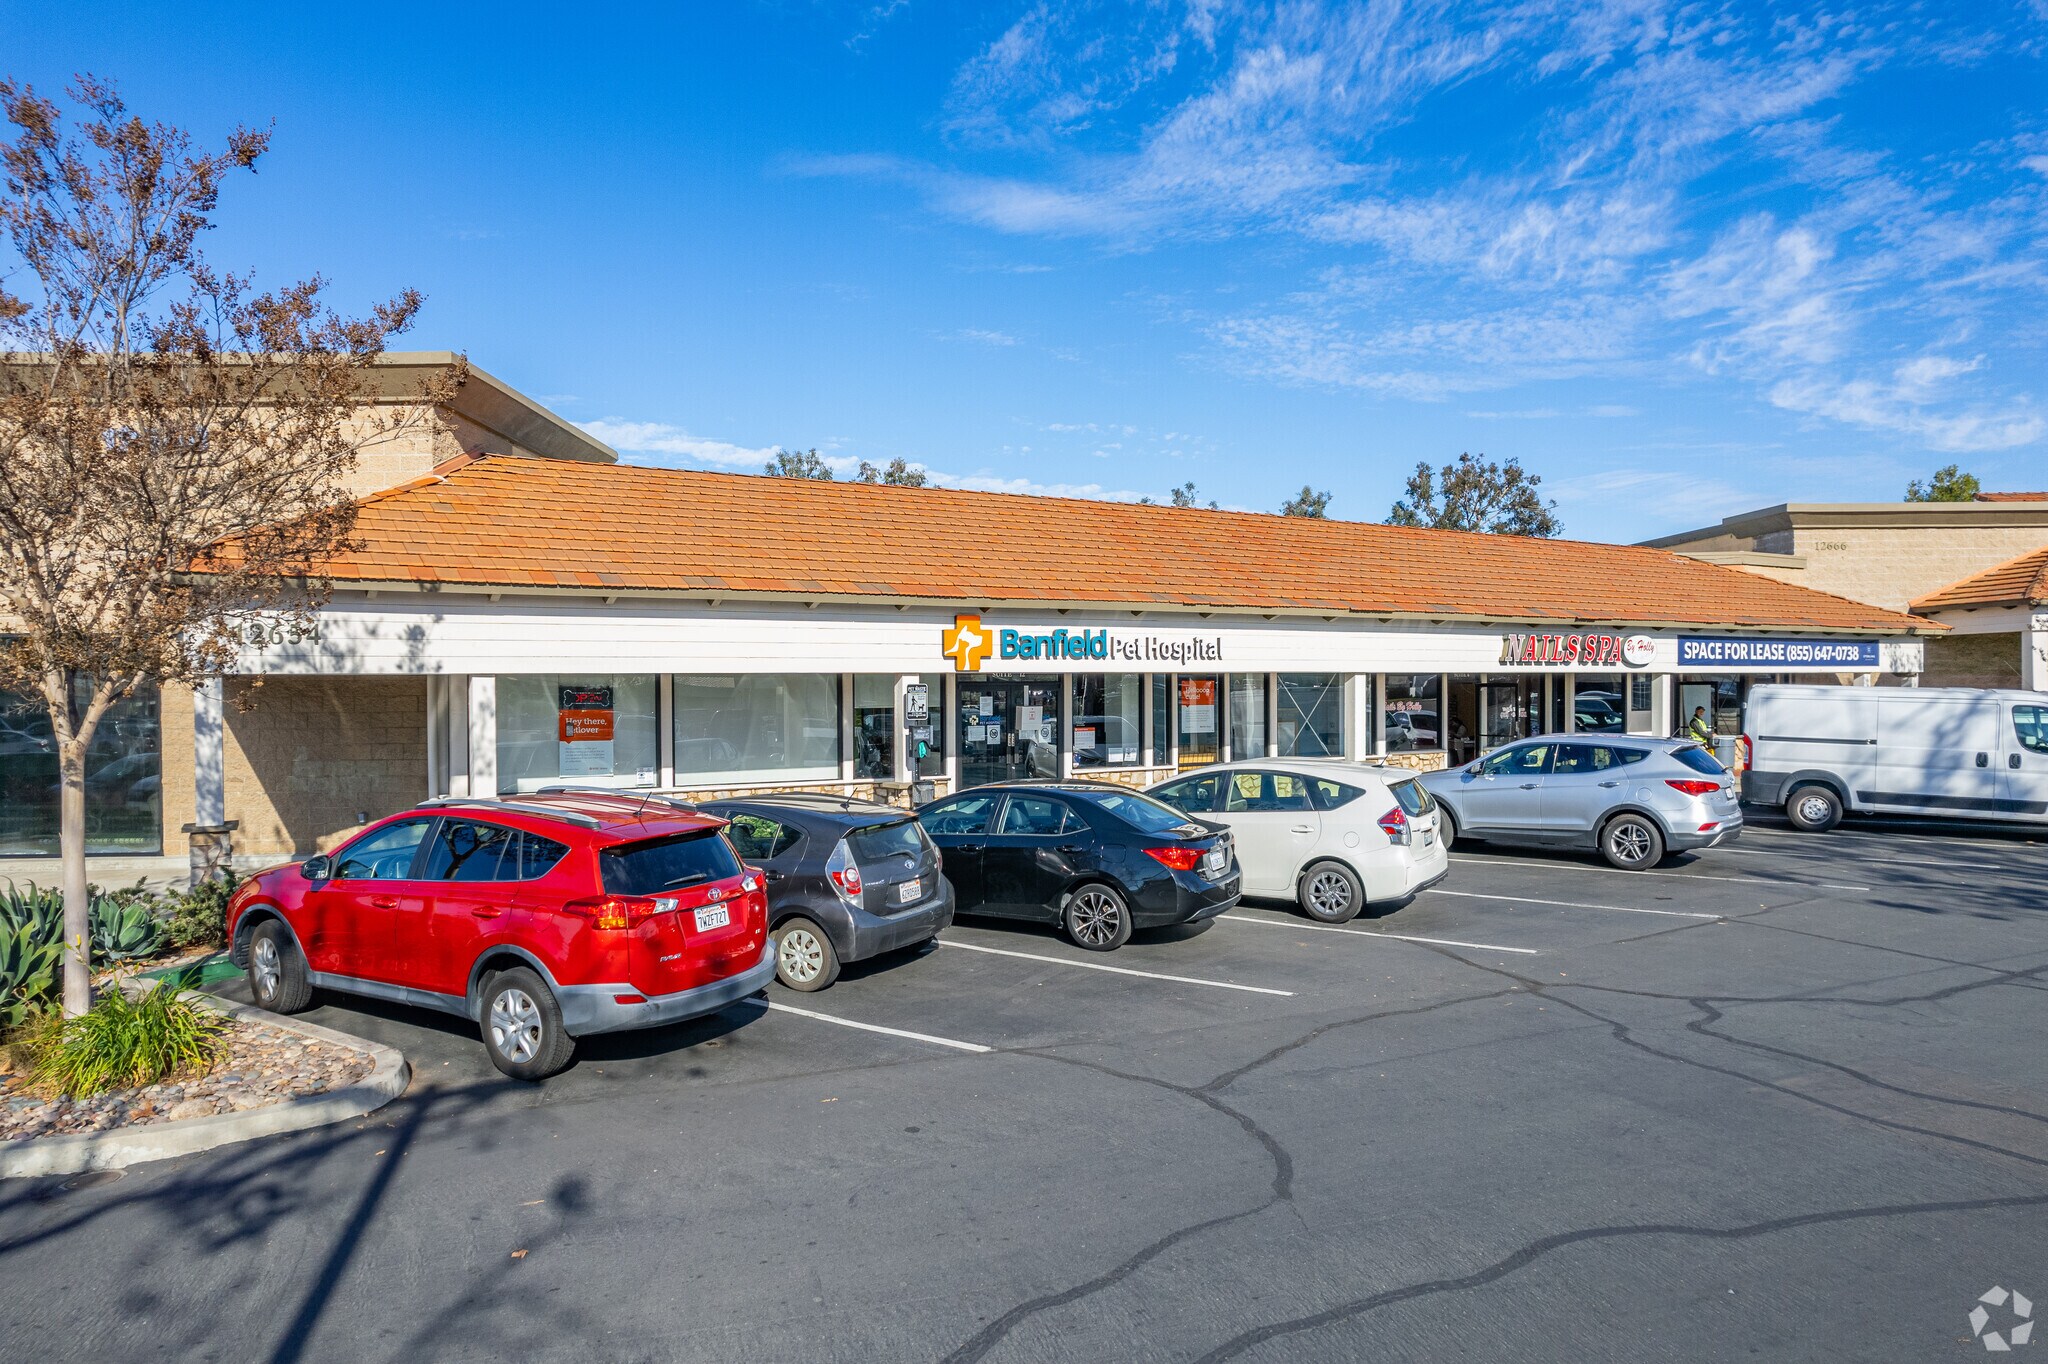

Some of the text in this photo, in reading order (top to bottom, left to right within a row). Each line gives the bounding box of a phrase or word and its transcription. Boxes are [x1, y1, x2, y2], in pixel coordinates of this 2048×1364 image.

[1815, 541, 1847, 551] 12666
[232, 622, 322, 645] 12654
[1000, 629, 1223, 666] Banfield Pet Hospital
[1501, 634, 1622, 663] NAILS SPA
[1626, 639, 1655, 655] By Holly
[1684, 642, 1860, 662] SPACE FOR LEASE (855) 647-0738
[583, 718, 608, 726] there,
[697, 911, 727, 929] 7WZF727
